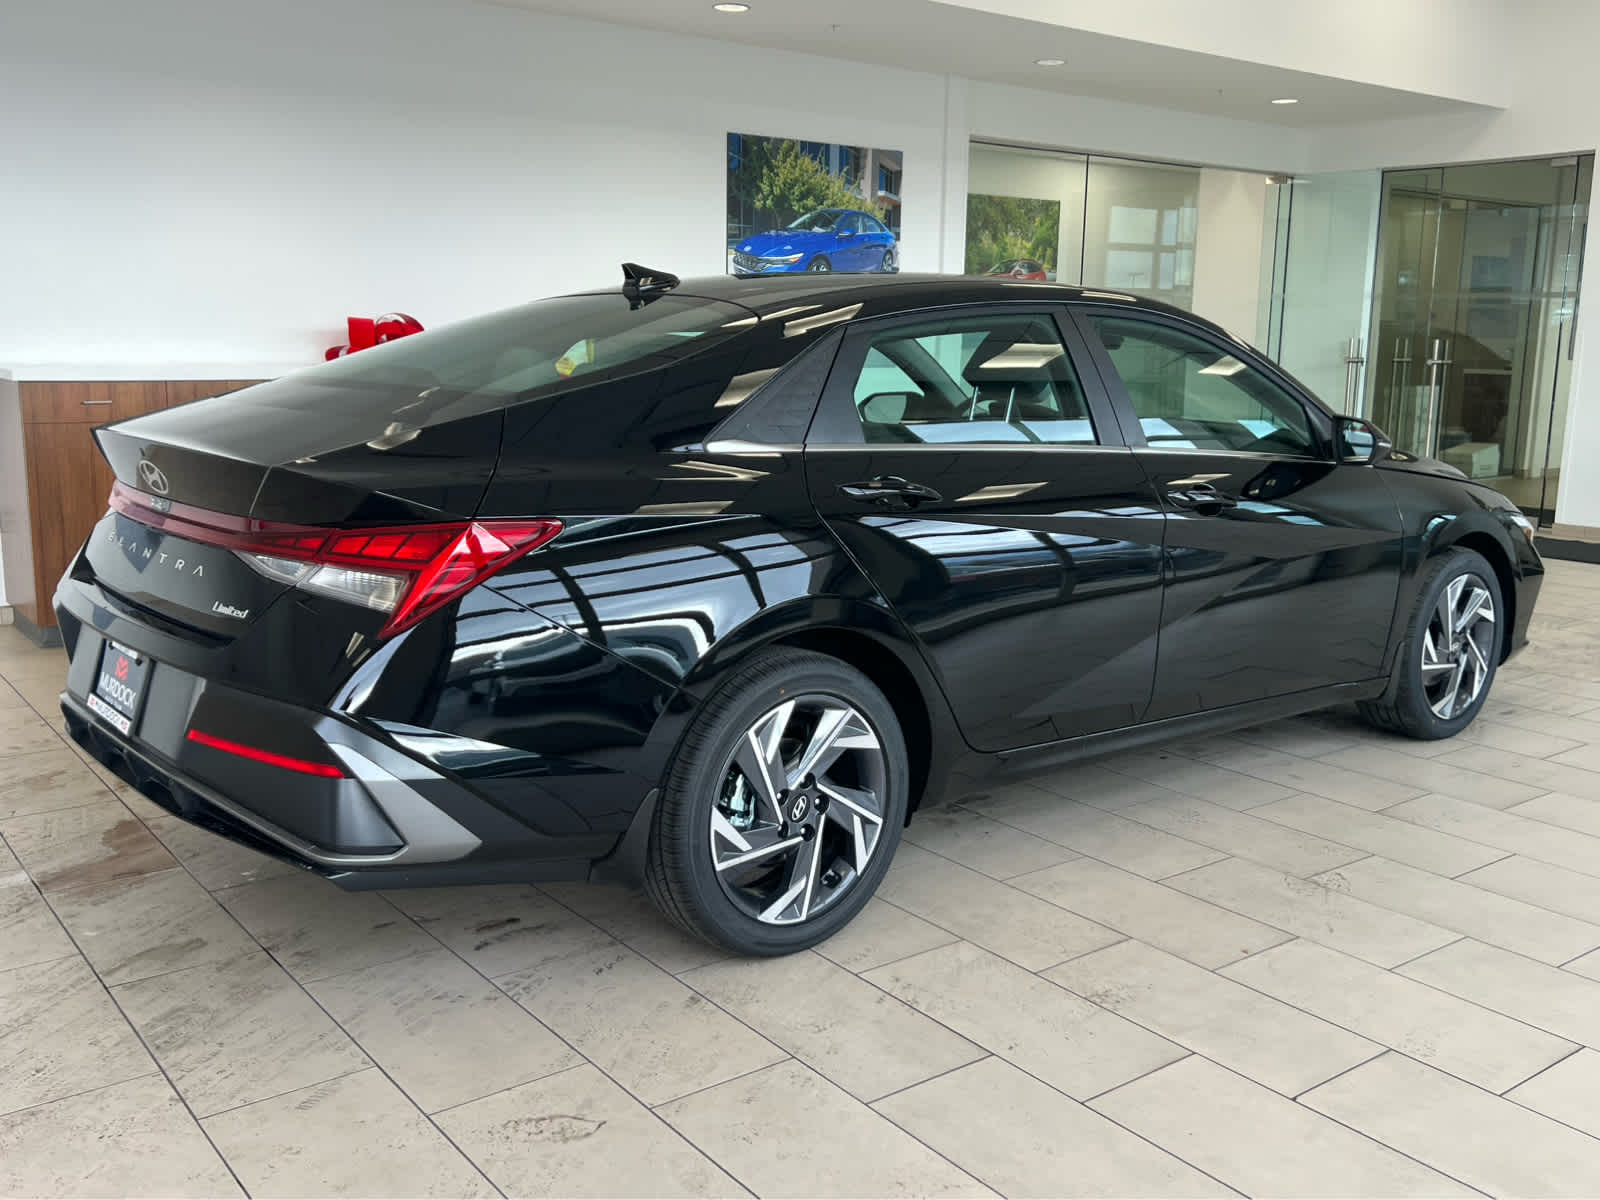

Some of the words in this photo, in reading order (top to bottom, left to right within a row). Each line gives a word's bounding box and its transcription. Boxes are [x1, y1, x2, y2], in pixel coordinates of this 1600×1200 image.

[107, 528, 204, 577] ELANTRA
[212, 600, 249, 619] Limited
[100, 671, 137, 710] MURDOCK
